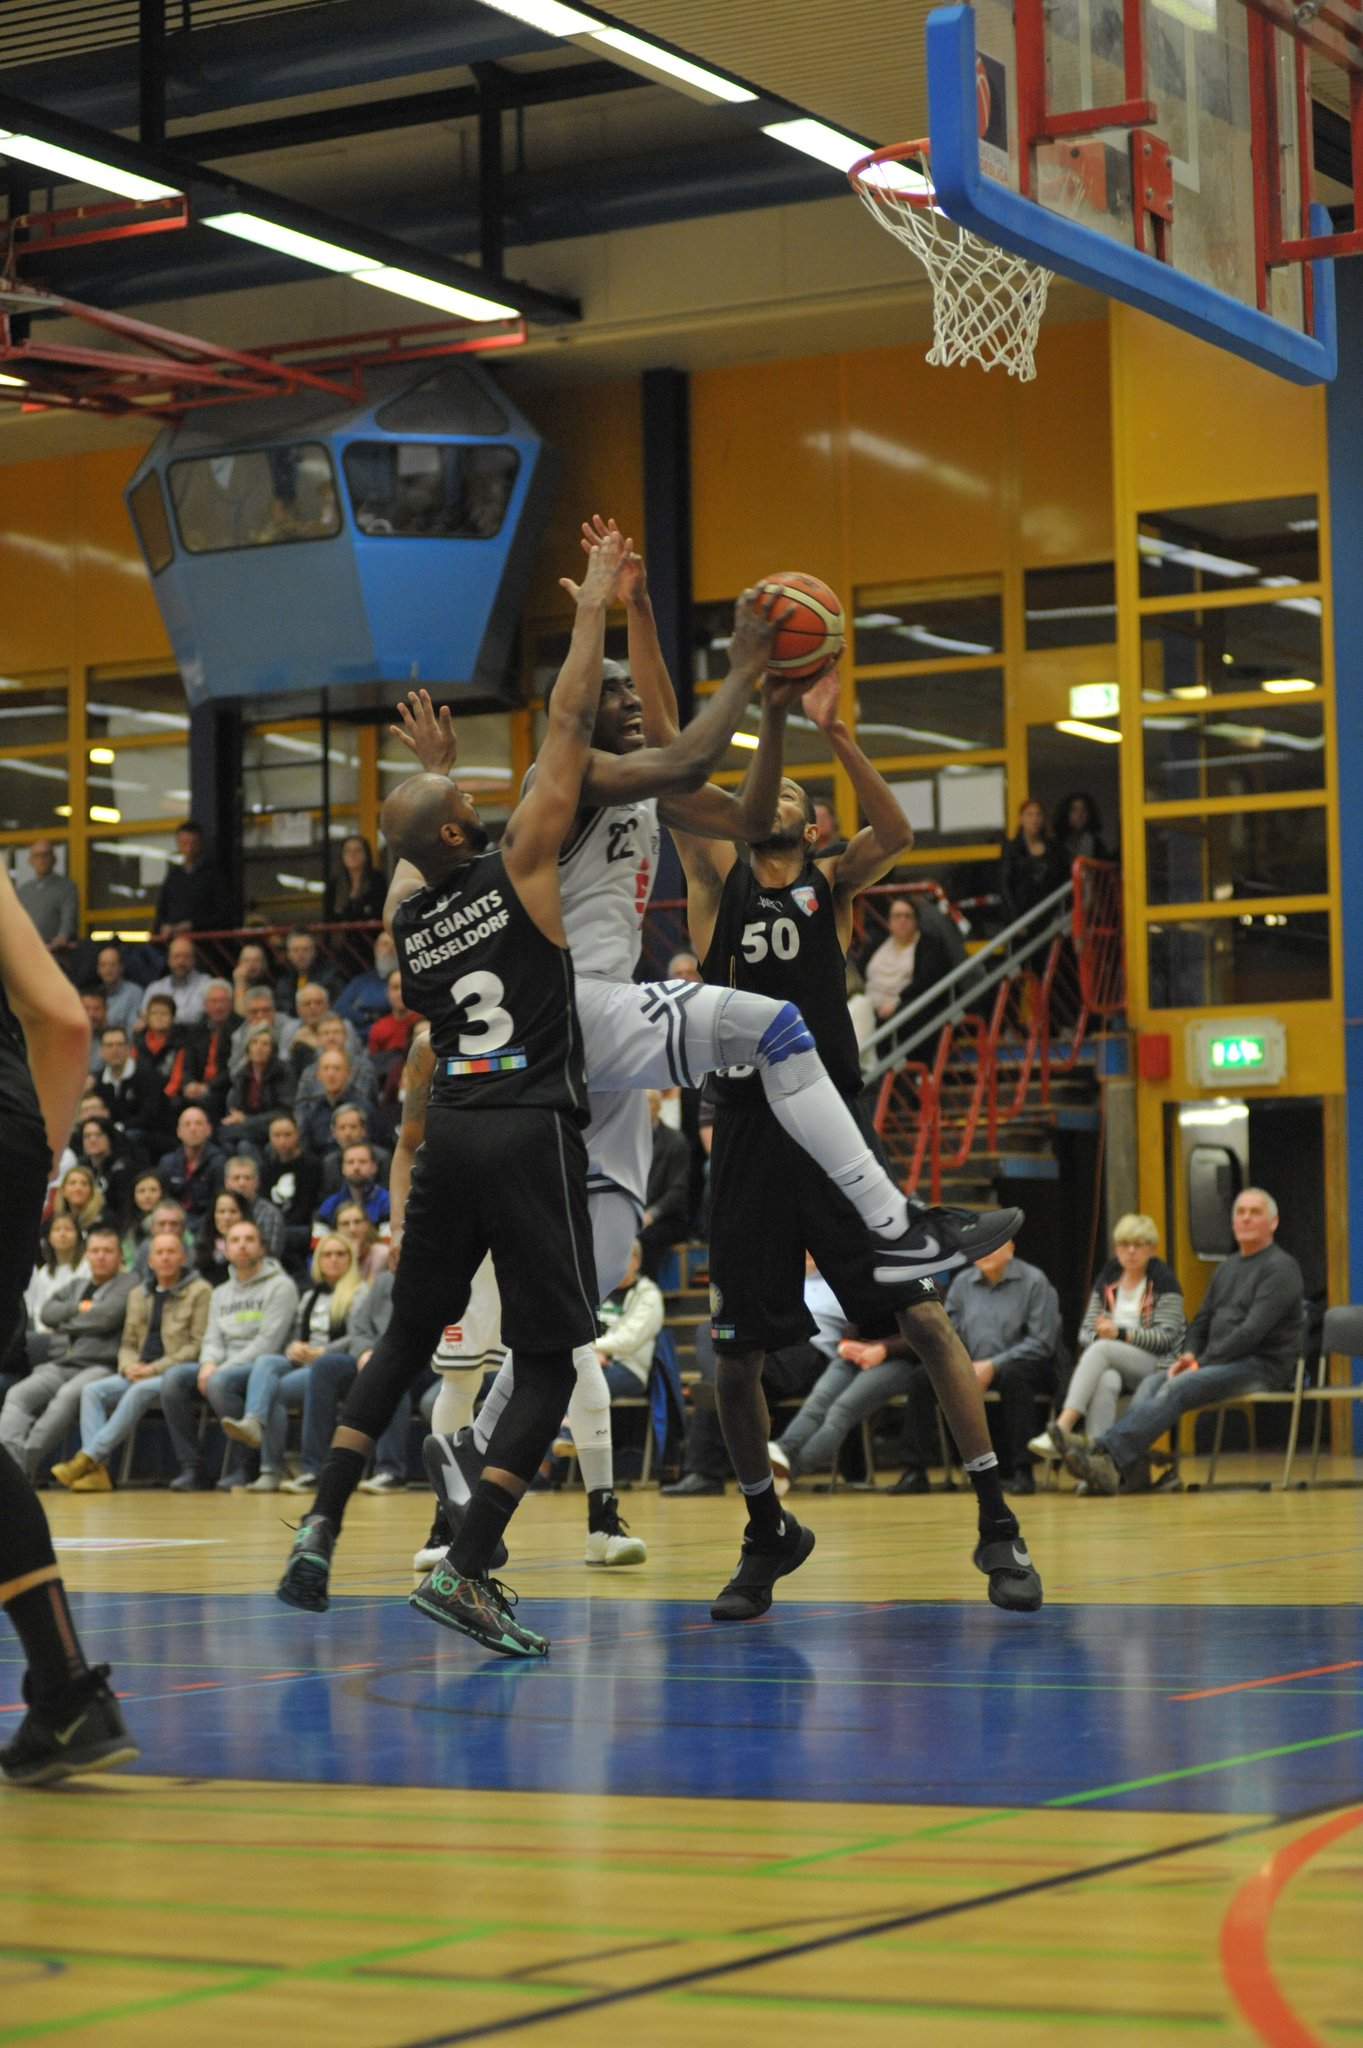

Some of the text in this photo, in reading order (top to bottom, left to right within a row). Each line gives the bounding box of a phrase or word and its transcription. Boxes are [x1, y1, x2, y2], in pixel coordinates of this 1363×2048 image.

[404, 889, 503, 955] ART GIANTS
[408, 909, 510, 975] DÜSSELDORF
[741, 917, 800, 964] 50
[450, 970, 514, 1056] 3
